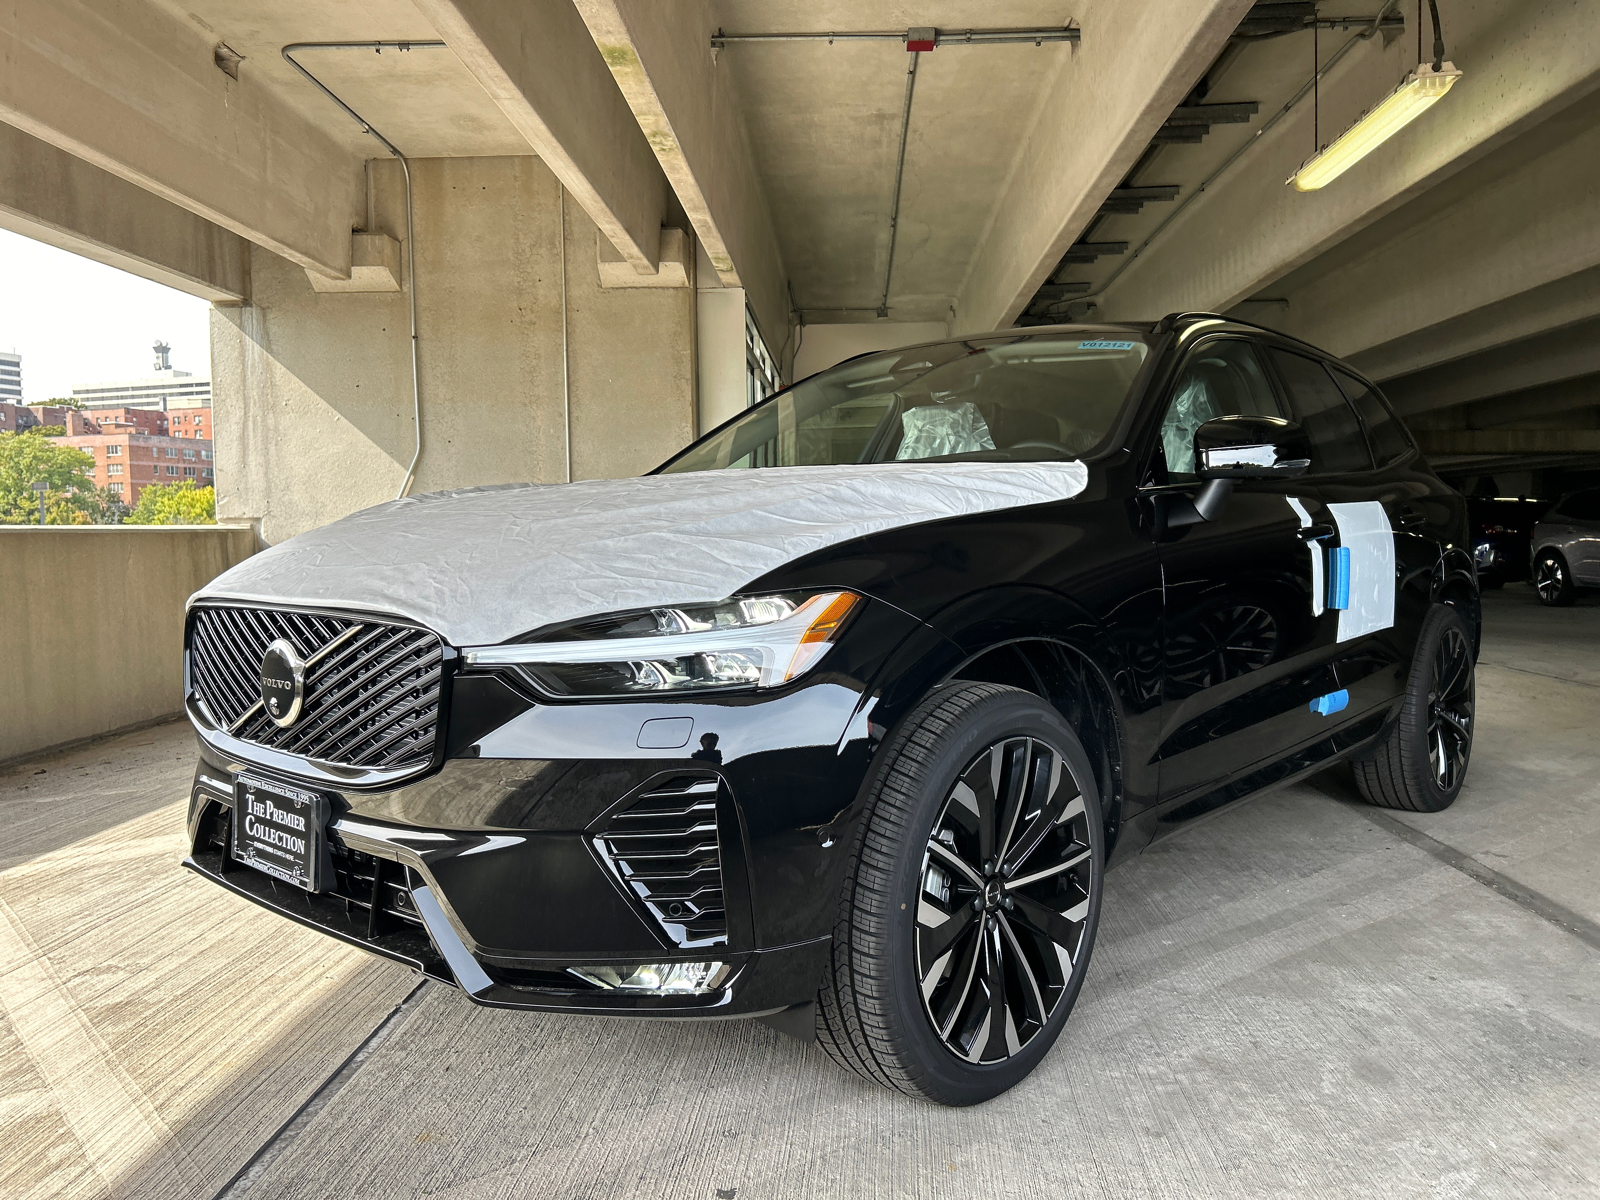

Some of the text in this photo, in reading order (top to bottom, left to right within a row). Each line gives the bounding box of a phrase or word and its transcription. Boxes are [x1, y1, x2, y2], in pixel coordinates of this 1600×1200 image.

[262, 677, 292, 690] VOLVO
[246, 794, 305, 832] THE PREMIER
[246, 815, 305, 854] COLLECTION
